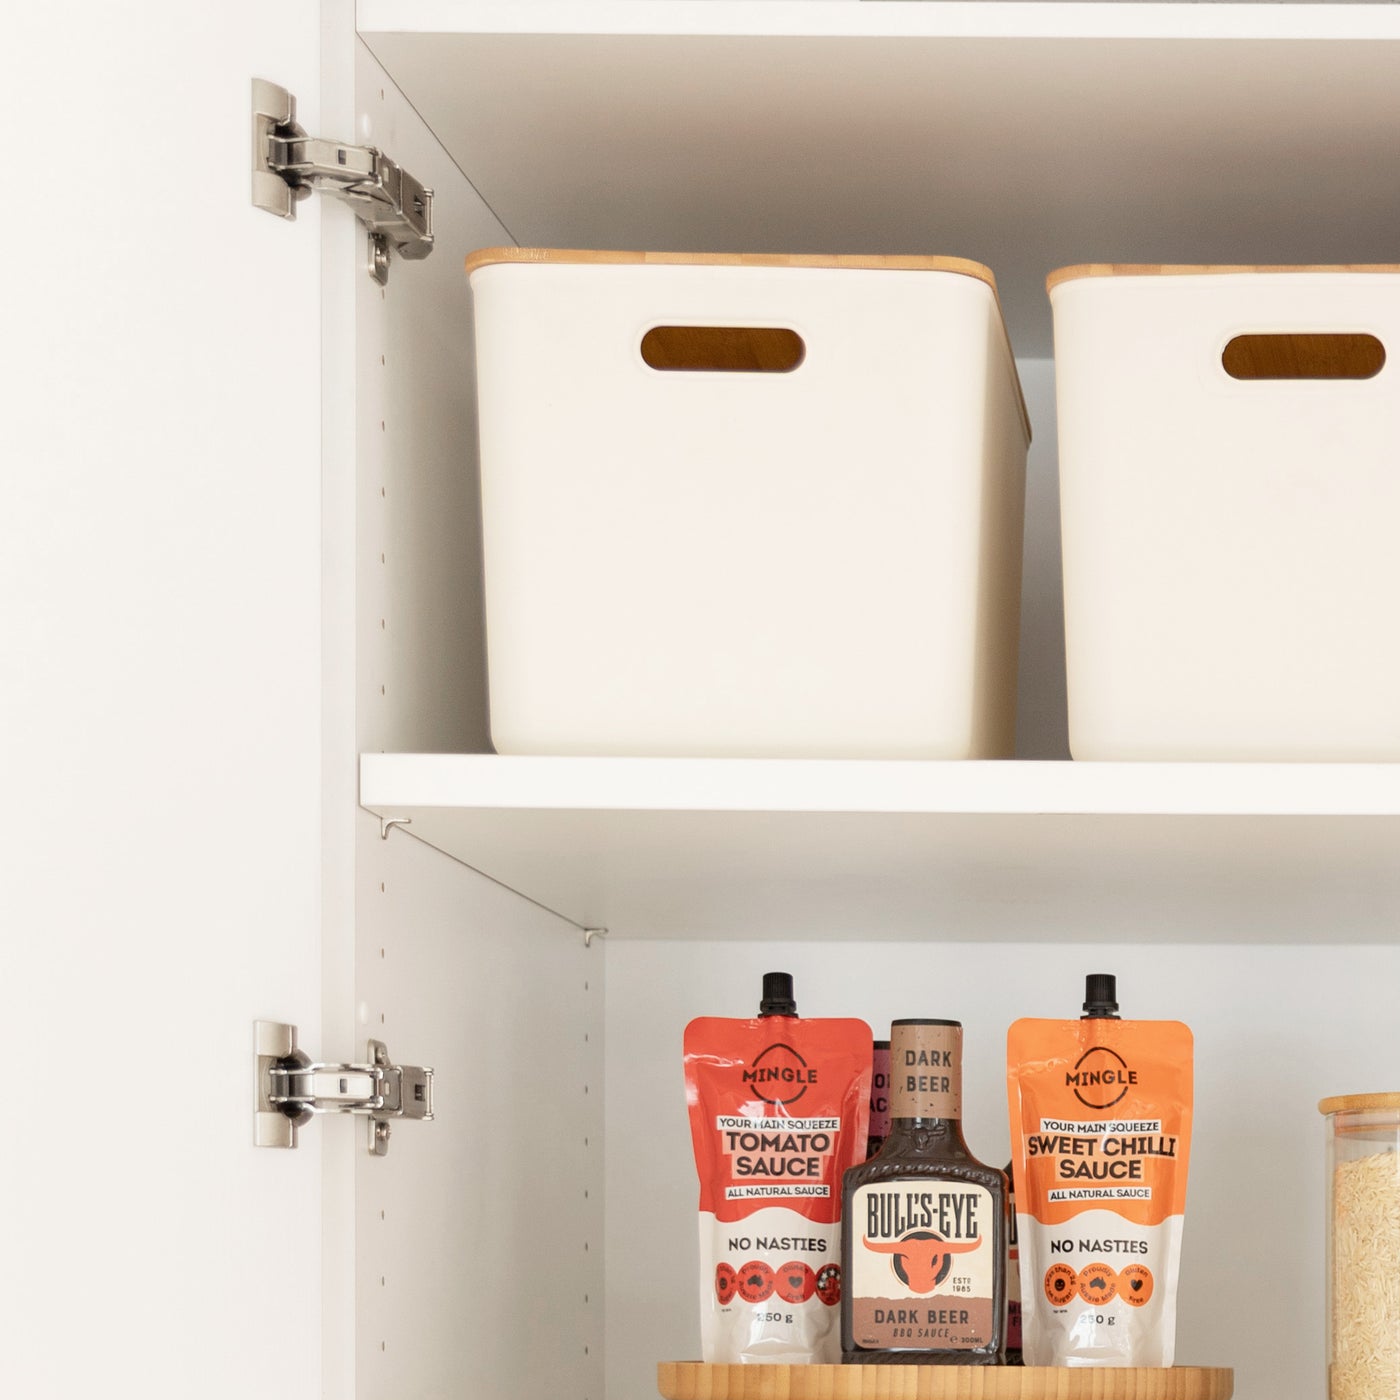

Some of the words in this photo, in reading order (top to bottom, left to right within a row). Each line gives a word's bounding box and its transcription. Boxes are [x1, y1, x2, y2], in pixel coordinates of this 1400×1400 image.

[905, 1050, 952, 1067] DARK
[742, 1067, 818, 1083] MINGLE
[1065, 1070, 1138, 1086] MINGLE
[906, 1076, 950, 1093] BEER
[719, 1118, 751, 1128] YOUR
[787, 1119, 838, 1129] SQUEEZE
[1043, 1121, 1075, 1132] YOUR
[1077, 1122, 1107, 1133] MAIN
[1109, 1121, 1159, 1132] SQUEEZE
[726, 1131, 830, 1152] TOMATO
[1028, 1135, 1097, 1156] SWEET
[1103, 1136, 1176, 1157] CHILLI
[736, 1156, 820, 1176] SAUCE
[1060, 1159, 1141, 1180] SAUCE
[727, 1188, 743, 1198] ALL
[746, 1187, 792, 1197] NATURAL
[794, 1186, 829, 1196] SAUCE
[1050, 1190, 1067, 1201] ALL
[1069, 1189, 1115, 1199] NATURAL
[1116, 1188, 1150, 1198] SAUCE
[867, 1193, 978, 1239] BULL'S-EYE
[729, 1238, 751, 1251] NO
[756, 1237, 827, 1252] NASTIES
[1051, 1239, 1074, 1253] NO
[1079, 1239, 1148, 1254] NASTIES
[874, 1309, 918, 1324] DARK
[927, 1310, 969, 1324] BEER
[893, 1328, 912, 1337] BBQ
[917, 1328, 949, 1338] SAUCE
